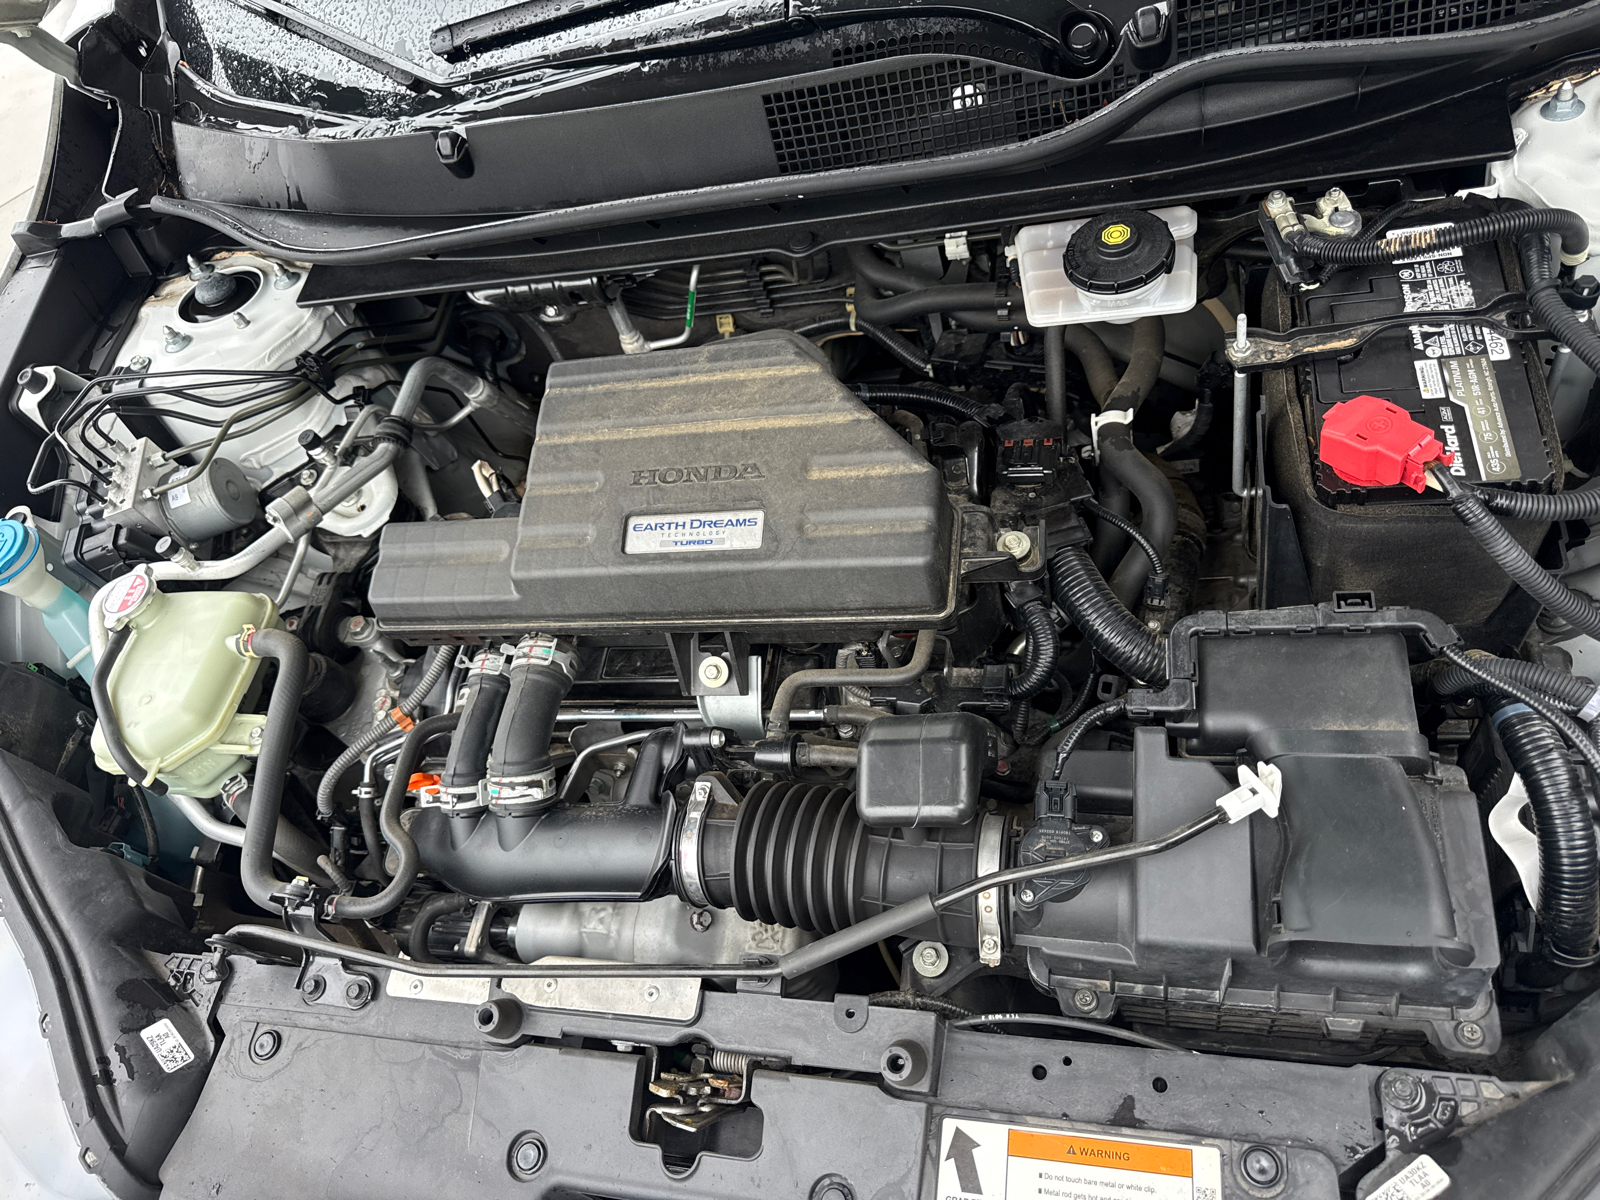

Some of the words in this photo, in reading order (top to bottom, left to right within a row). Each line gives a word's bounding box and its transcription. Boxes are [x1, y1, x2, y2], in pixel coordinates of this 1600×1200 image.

[1450, 360, 1465, 396] PLATINUM
[1440, 424, 1466, 476] DieHard
[630, 463, 765, 486] HONDA
[633, 522, 686, 532] EARTH
[690, 518, 758, 529] DREAMS
[188, 759, 216, 778] MIN
[155, 1033, 166, 1046] TLAA
[1079, 1146, 1130, 1162] WARNING
[1398, 1161, 1426, 1185] UA30KZ
[1409, 1170, 1429, 1187] TLAA
[1044, 1188, 1060, 1196] Metal
[1144, 1186, 1157, 1195] clip.
